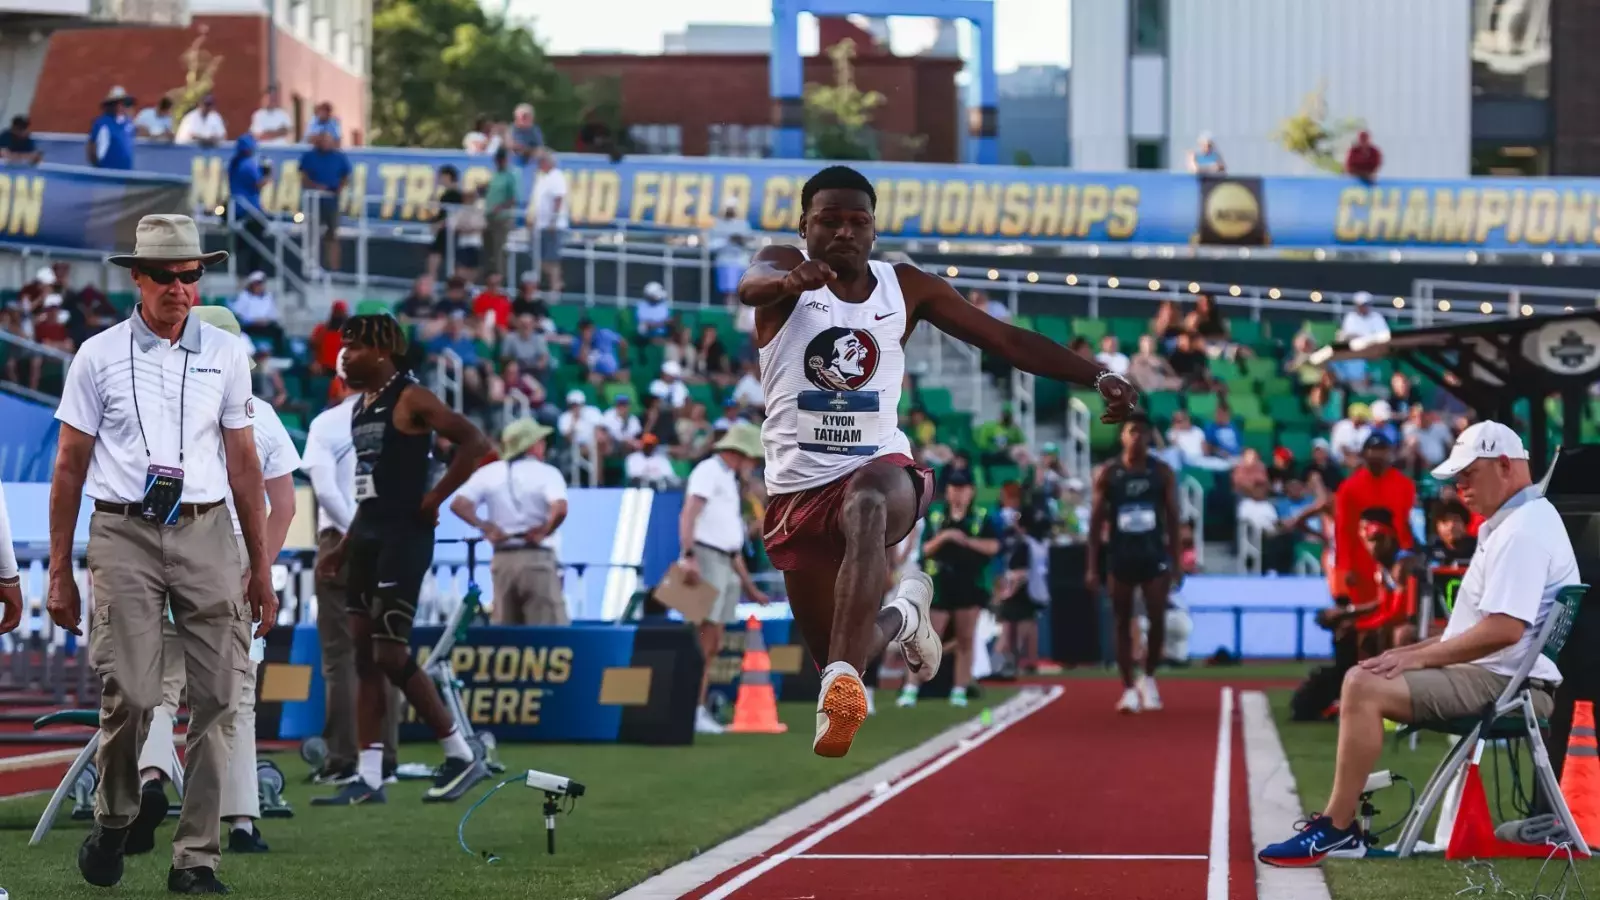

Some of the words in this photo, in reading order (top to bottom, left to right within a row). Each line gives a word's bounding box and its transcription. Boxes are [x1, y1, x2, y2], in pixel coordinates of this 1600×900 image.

[527, 169, 620, 225] ND
[630, 171, 751, 229] FIELD
[760, 175, 1139, 239] CPIONSHIPS
[1336, 186, 1600, 243] CHAMPION
[805, 300, 830, 312] ACC
[822, 414, 855, 427] KYVON
[813, 427, 862, 443] TATHAM
